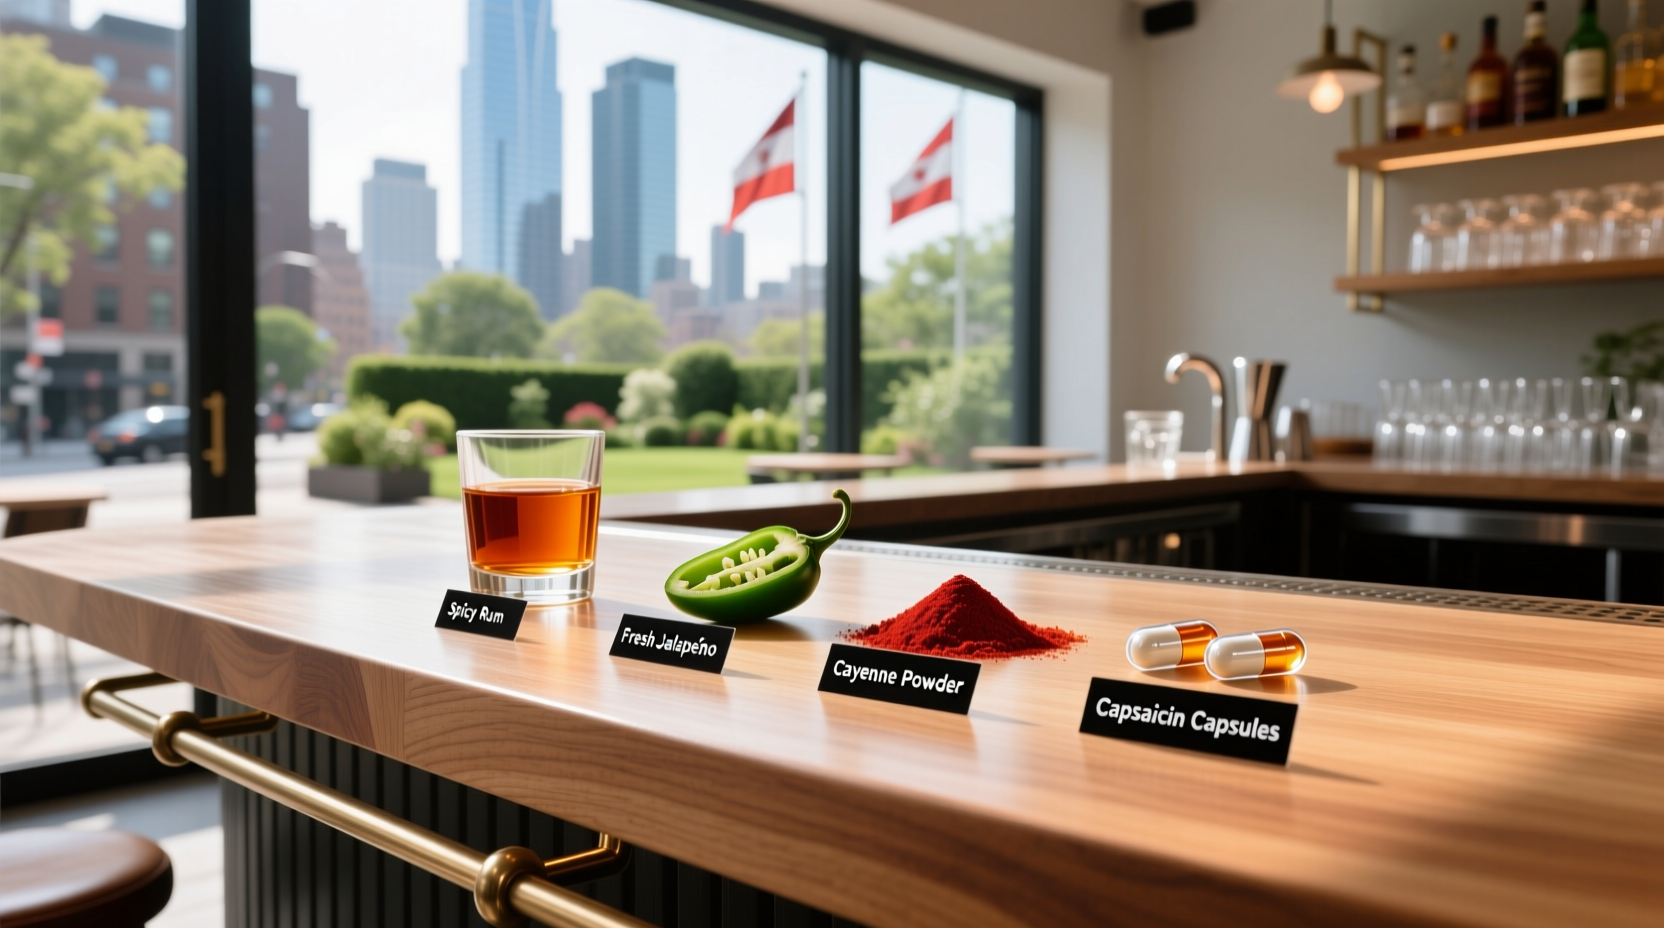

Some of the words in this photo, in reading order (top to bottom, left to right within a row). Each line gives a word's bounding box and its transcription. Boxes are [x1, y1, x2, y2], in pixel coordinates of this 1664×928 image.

[447, 601, 477, 623] Spicy
[621, 627, 655, 648] Fresh
[833, 660, 897, 684] Cayenne
[901, 669, 965, 694] Powder
[1096, 697, 1186, 728] Capsaicin
[1190, 710, 1281, 742] Capsules
